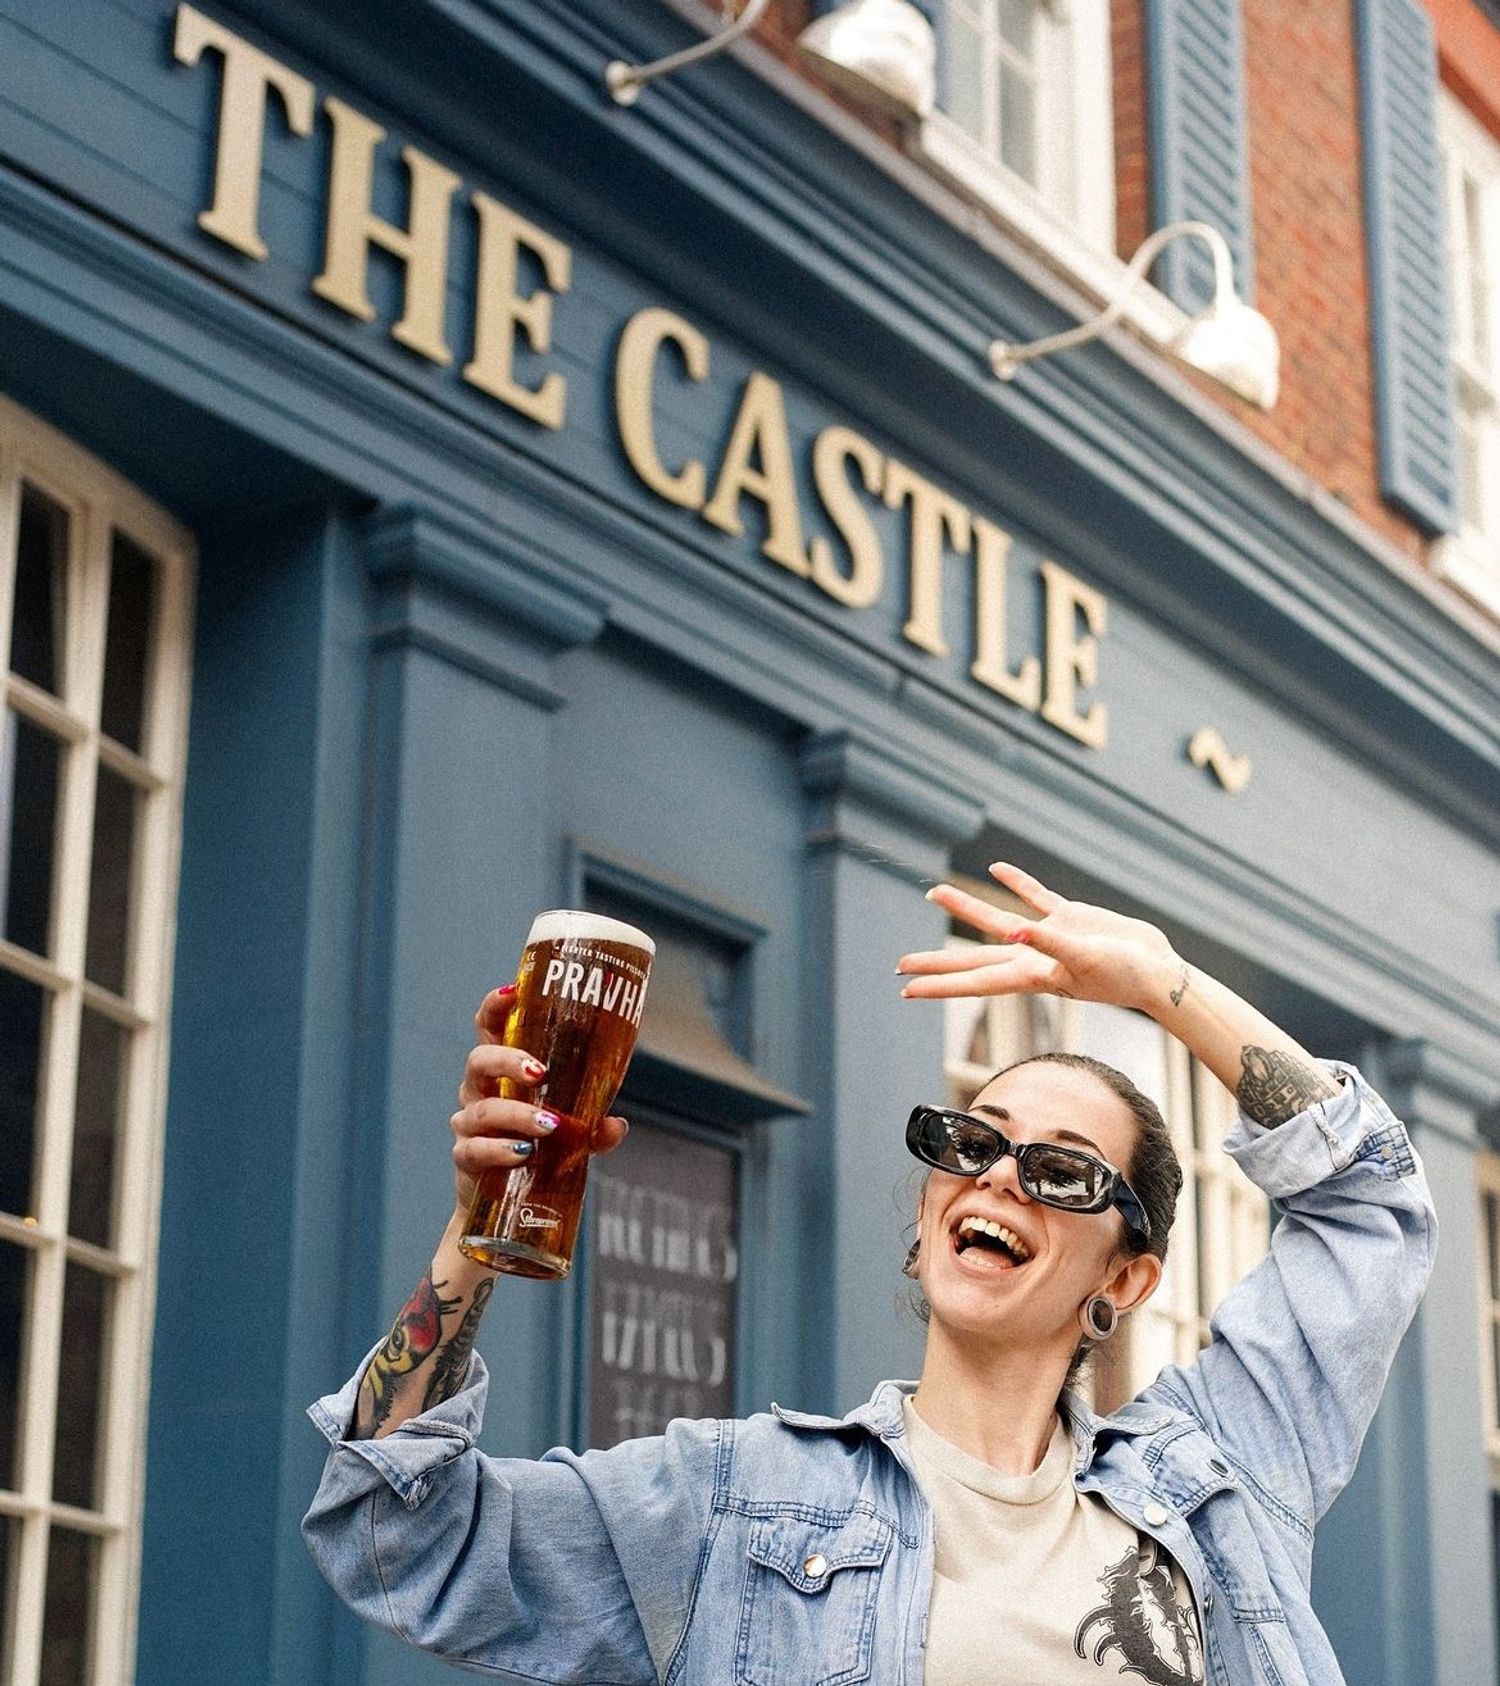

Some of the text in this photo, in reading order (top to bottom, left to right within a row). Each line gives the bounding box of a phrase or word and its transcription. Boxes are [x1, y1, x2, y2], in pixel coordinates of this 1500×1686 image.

[174, 2, 1108, 750] THE CASTLE
[542, 959, 649, 1029] PRAVHA
[595, 951, 626, 968] TASTING
